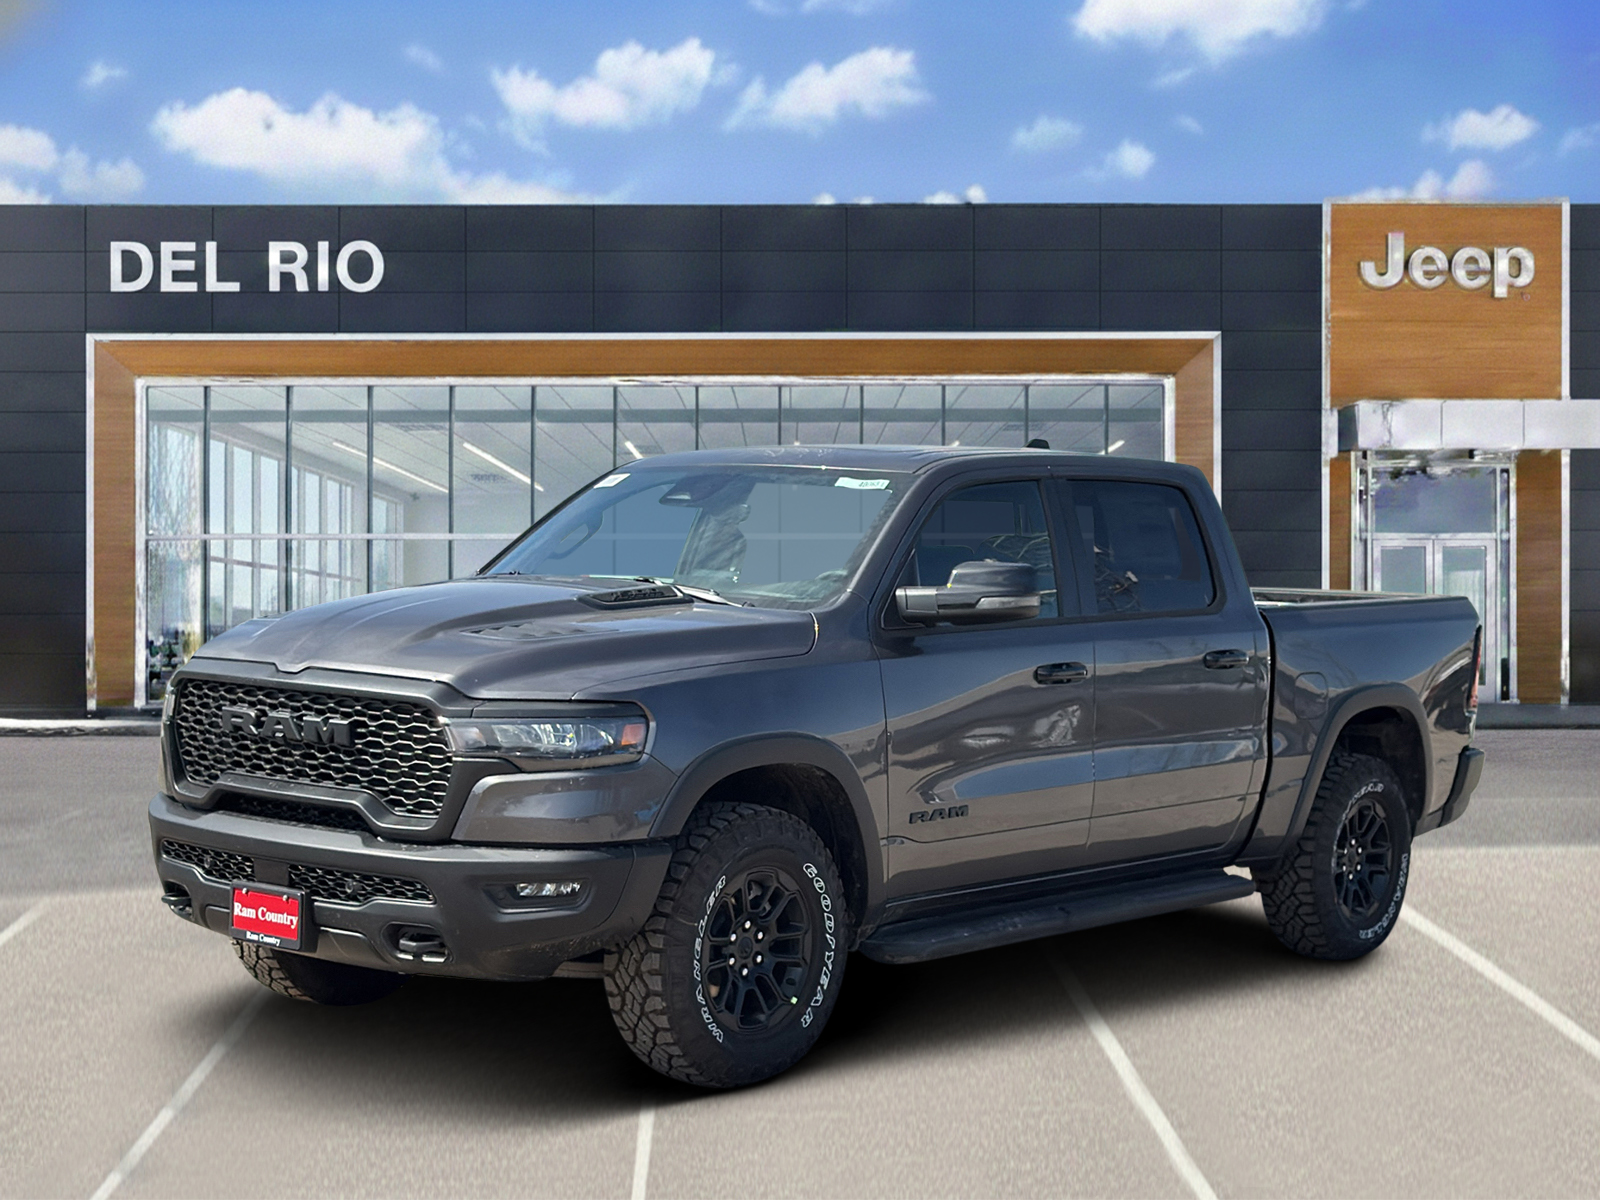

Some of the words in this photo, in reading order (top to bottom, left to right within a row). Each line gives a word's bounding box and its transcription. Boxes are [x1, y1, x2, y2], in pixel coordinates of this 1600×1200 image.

[110, 241, 240, 292] DEL
[268, 240, 385, 293] RIO
[1360, 231, 1535, 298] Jeep
[222, 706, 353, 748] RAM
[909, 804, 969, 824] RAM
[233, 902, 256, 919] Ram
[257, 906, 298, 930] Country
[801, 863, 836, 1028] GOODYEAR
